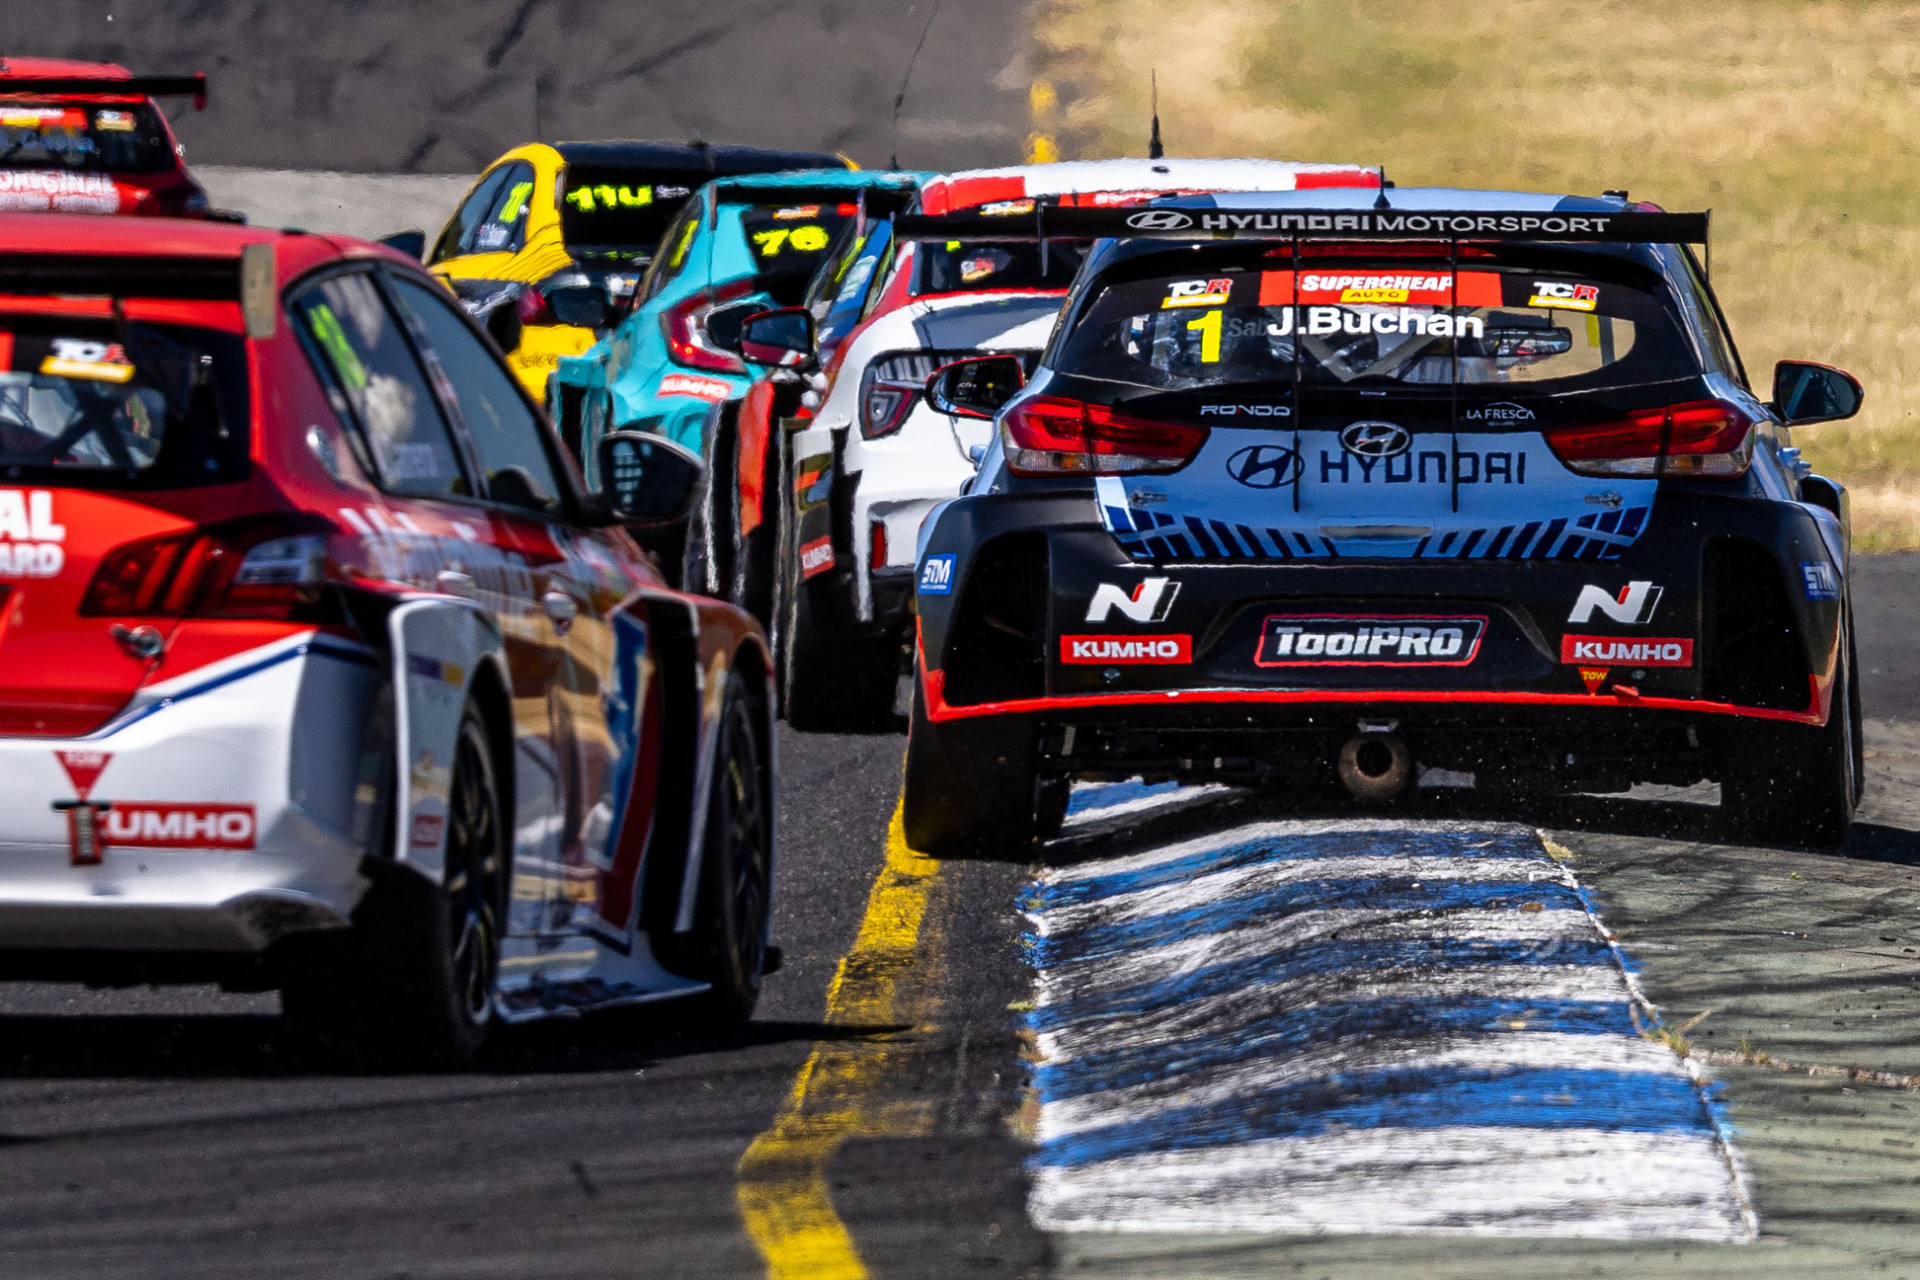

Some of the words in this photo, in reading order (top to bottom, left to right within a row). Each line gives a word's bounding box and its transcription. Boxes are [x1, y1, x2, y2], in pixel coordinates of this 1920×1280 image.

[1202, 214, 1370, 230] HYUNDAI
[1377, 216, 1611, 233] MOTORSPORT
[1168, 278, 1233, 298] TCR
[1302, 275, 1453, 292] SUPERCHEAP
[1533, 281, 1599, 301] TCR
[1350, 291, 1400, 299] AUTO
[1267, 306, 1484, 339] J.Buchan
[1187, 310, 1222, 363] 1
[1466, 409, 1482, 420] LA
[1484, 408, 1536, 420] FRESCA
[1320, 450, 1526, 484] HYUNDAI
[1072, 640, 1179, 658] KUMHO
[1574, 641, 1682, 661] KUMHO
[1582, 671, 1607, 680] TOW
